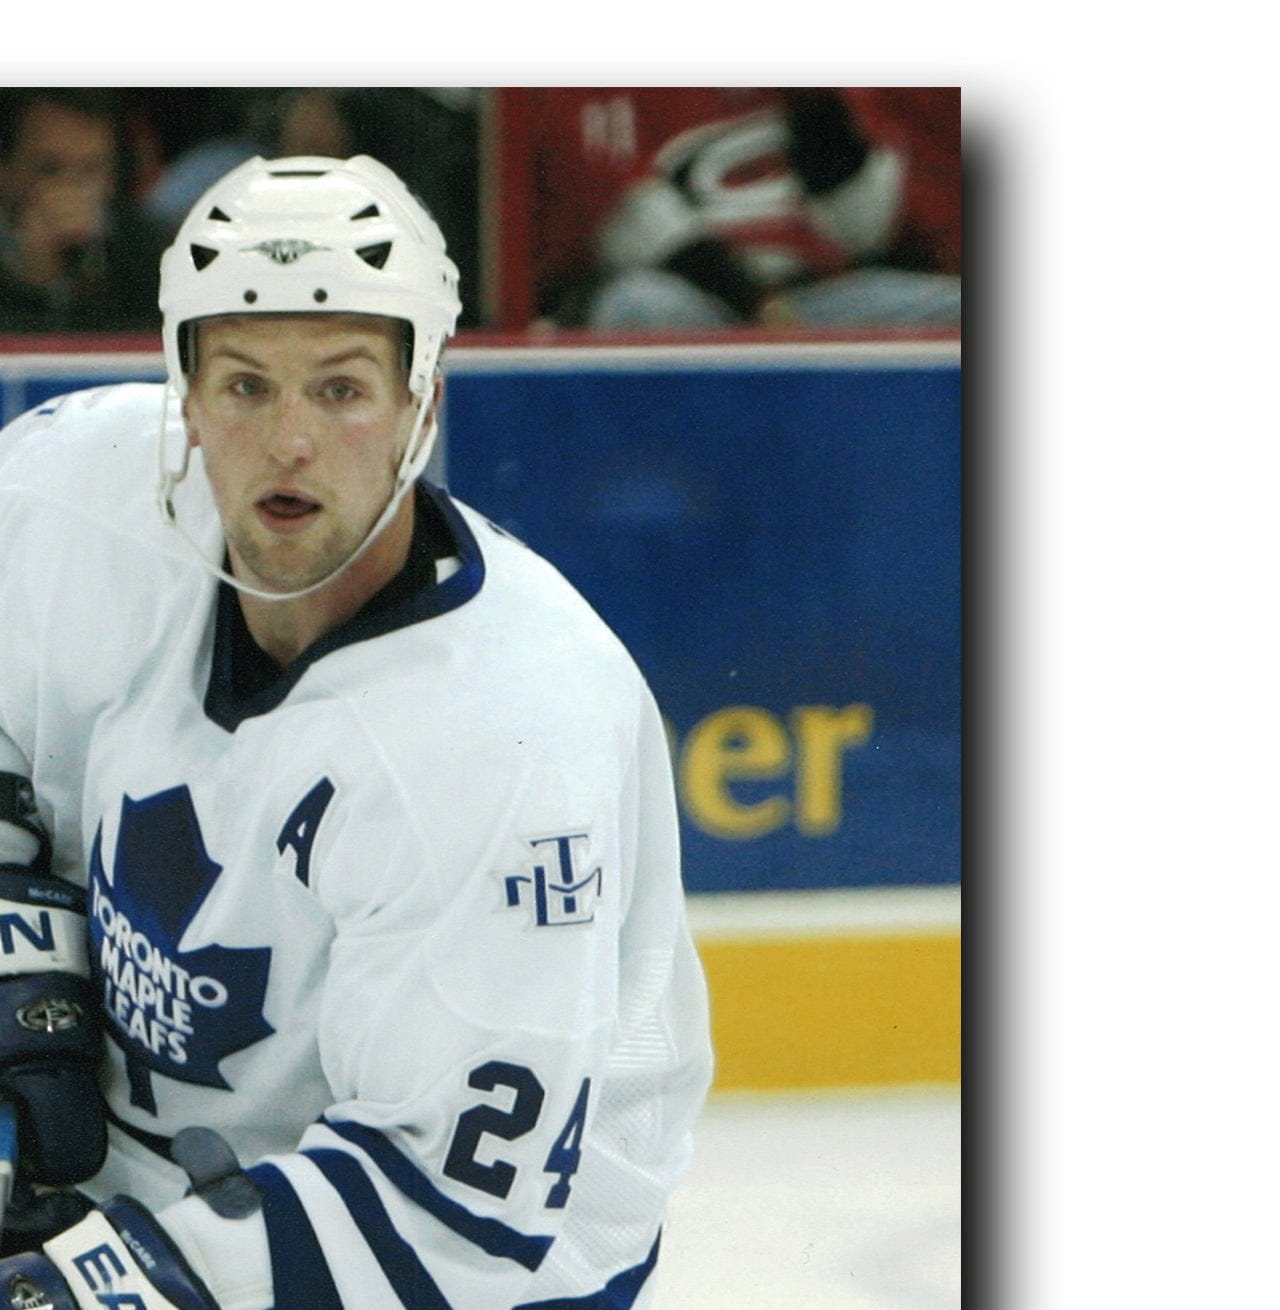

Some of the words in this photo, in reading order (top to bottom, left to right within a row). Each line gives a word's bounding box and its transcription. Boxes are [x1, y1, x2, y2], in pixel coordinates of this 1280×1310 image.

[277, 777, 335, 888] A
[93, 876, 228, 1009] TORONTO
[102, 936, 195, 1035] MAPLE
[443, 1060, 591, 1208] 24
